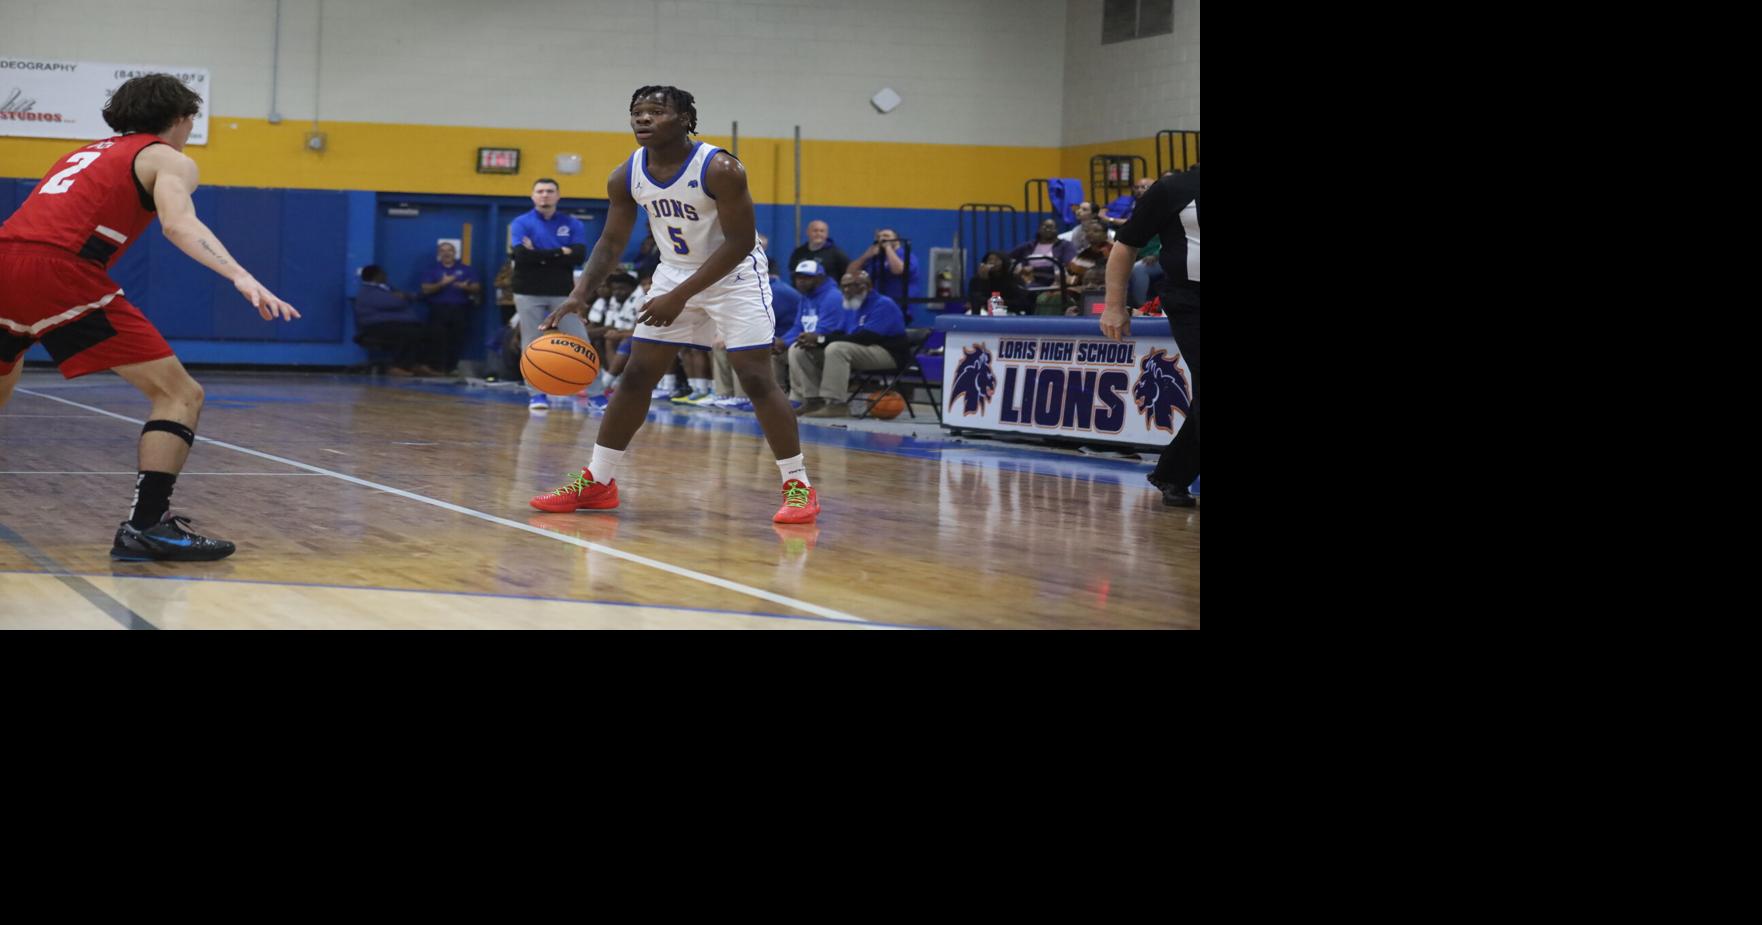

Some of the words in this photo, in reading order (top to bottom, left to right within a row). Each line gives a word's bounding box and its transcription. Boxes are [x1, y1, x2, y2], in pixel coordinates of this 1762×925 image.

[0, 111, 63, 122] STUDIOS
[38, 150, 101, 195] 2
[666, 225, 689, 255] 5
[550, 338, 597, 365] Wilson
[998, 339, 1037, 361] LORIS
[1039, 340, 1075, 362] HIGH
[1076, 341, 1135, 364] SCHOOL
[999, 364, 1129, 433] LIONS
